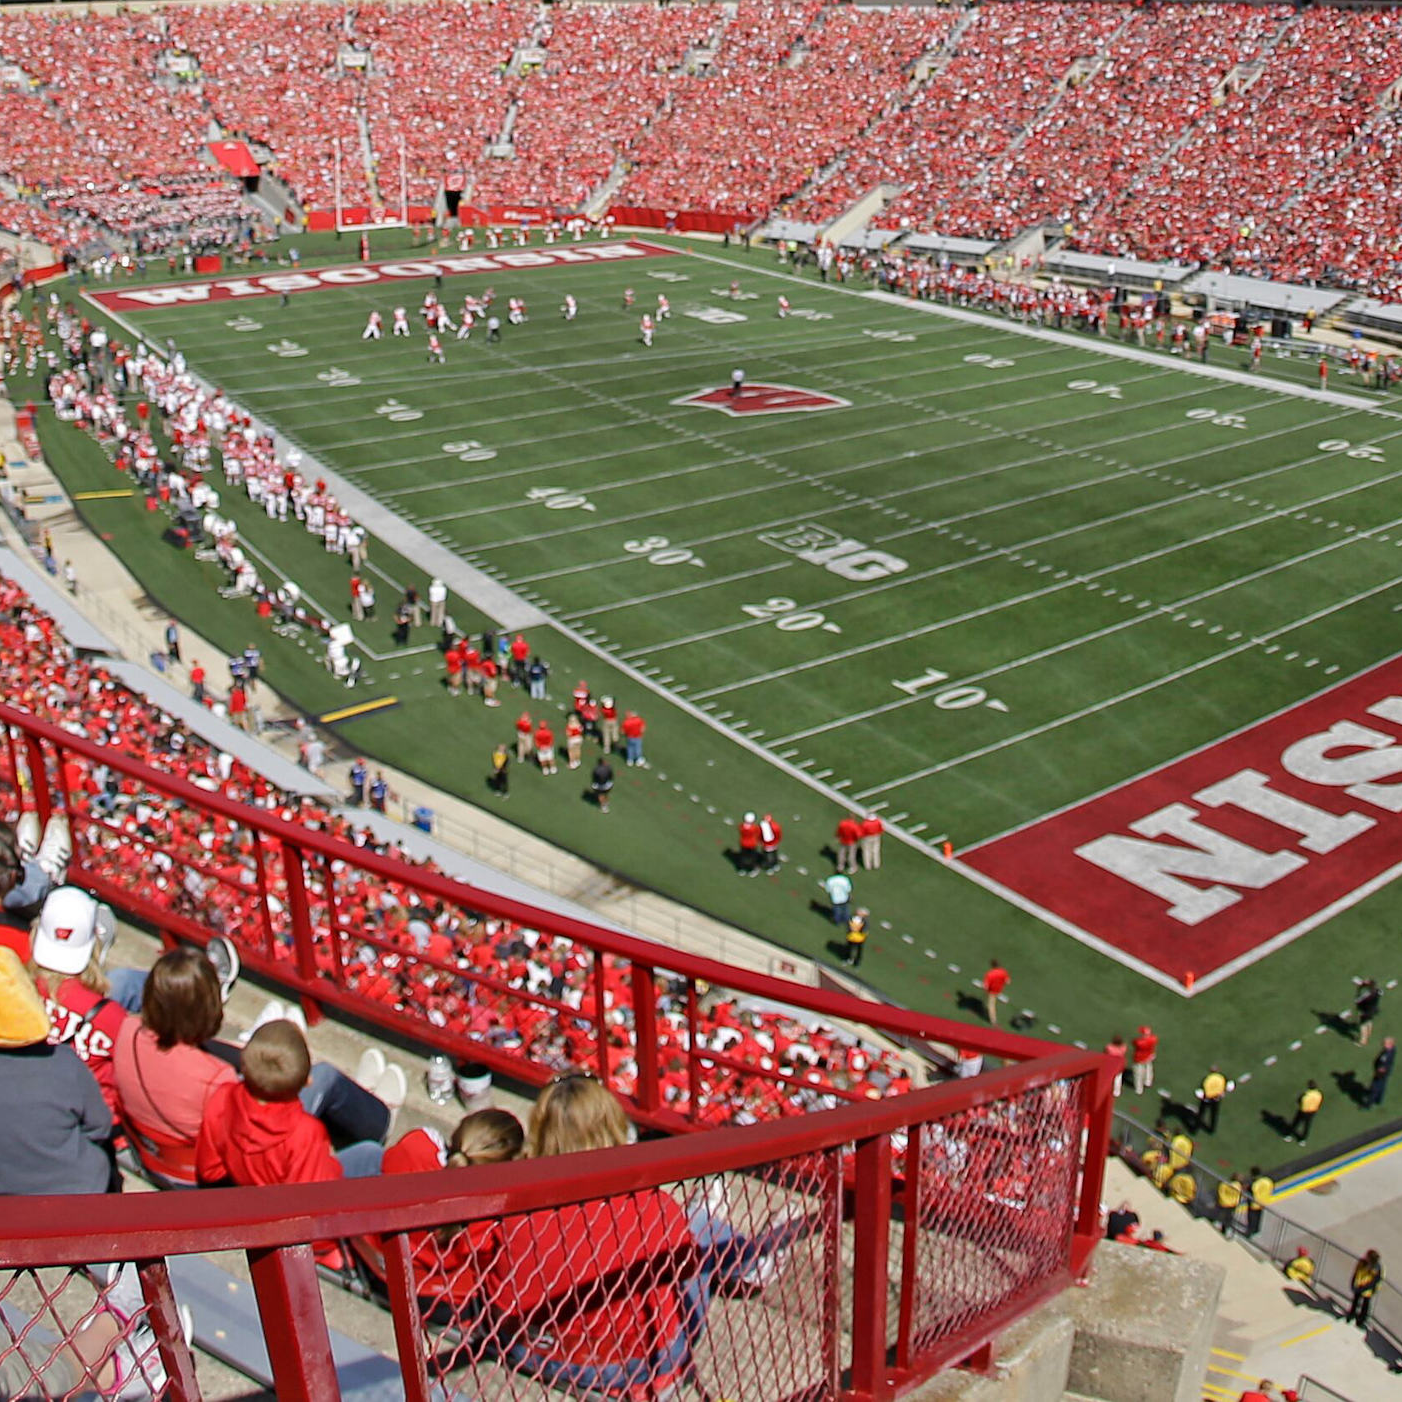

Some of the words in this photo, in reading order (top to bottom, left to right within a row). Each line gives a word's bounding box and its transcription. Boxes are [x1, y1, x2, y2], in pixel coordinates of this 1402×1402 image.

[117, 244, 646, 305] WISCONSIN
[442, 440, 498, 462] 50
[526, 486, 587, 509] 40
[623, 536, 694, 566] 30
[741, 597, 825, 631] 20
[891, 667, 987, 710] 10
